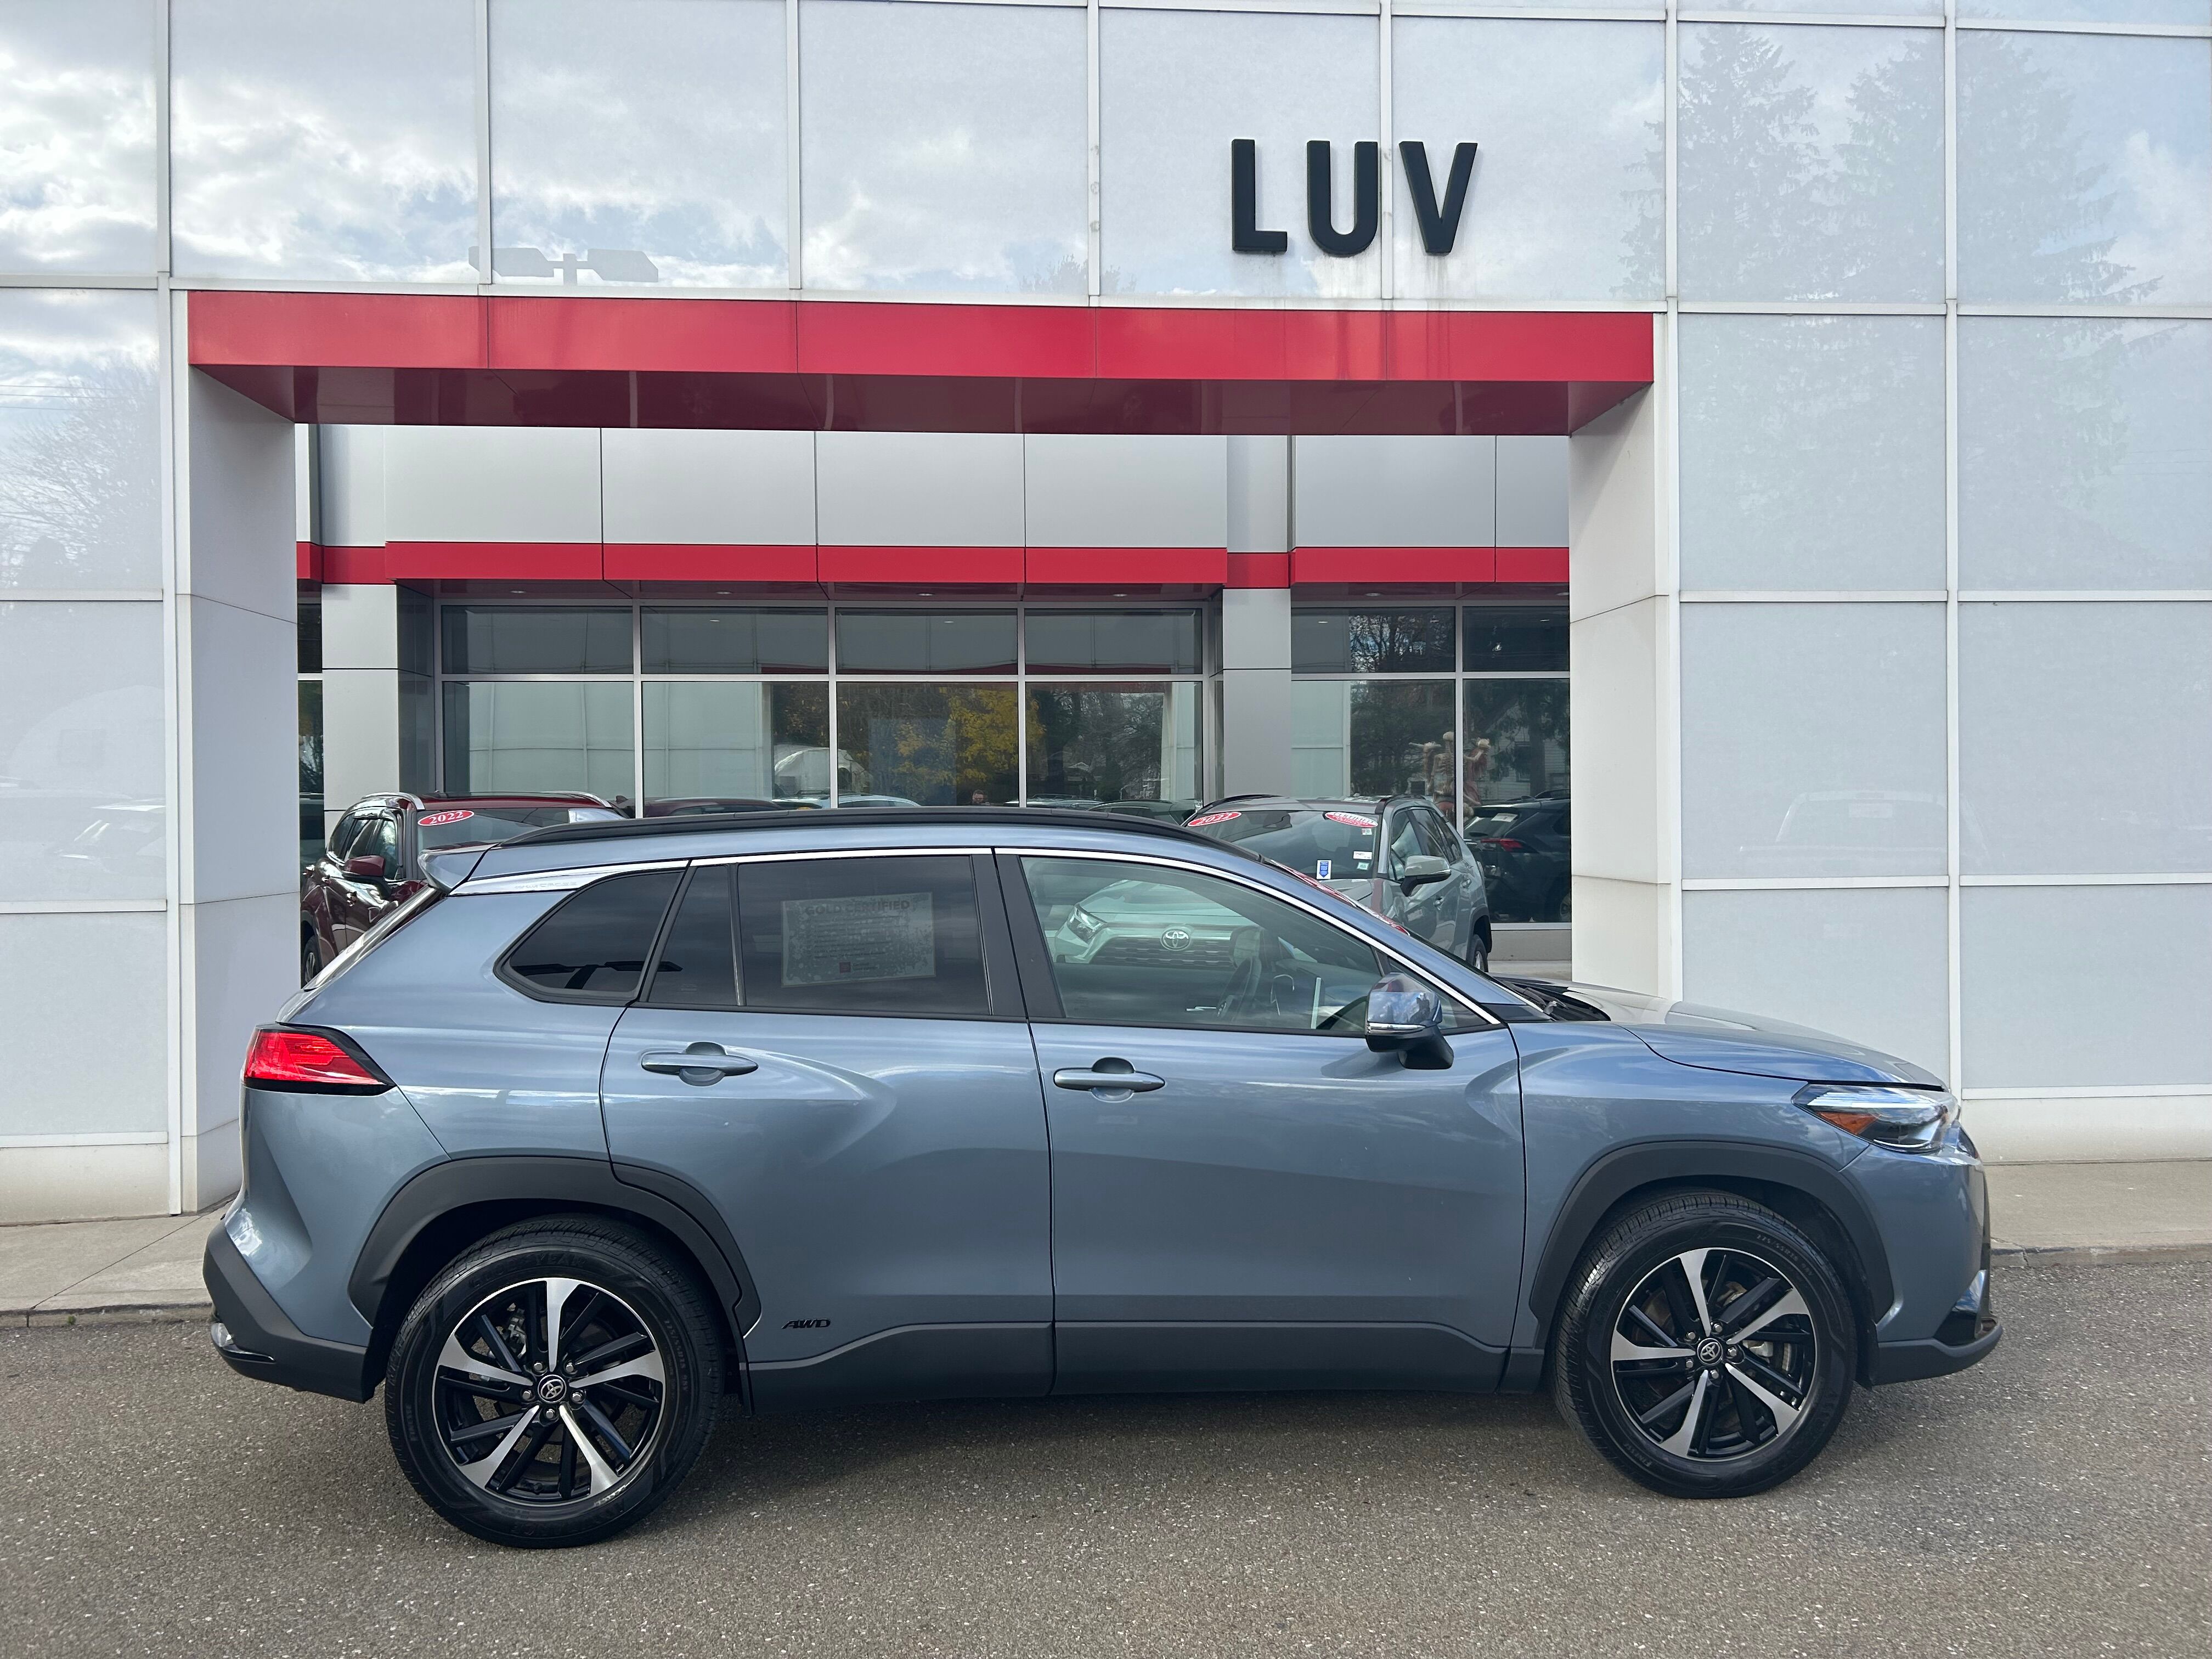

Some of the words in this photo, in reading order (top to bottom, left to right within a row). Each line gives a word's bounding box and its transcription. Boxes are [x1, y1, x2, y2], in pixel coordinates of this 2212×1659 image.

[1232, 139, 1478, 256] LUV
[429, 811, 464, 825] 2022
[1196, 812, 1233, 825] 2022
[781, 1318, 831, 1329] AWD
